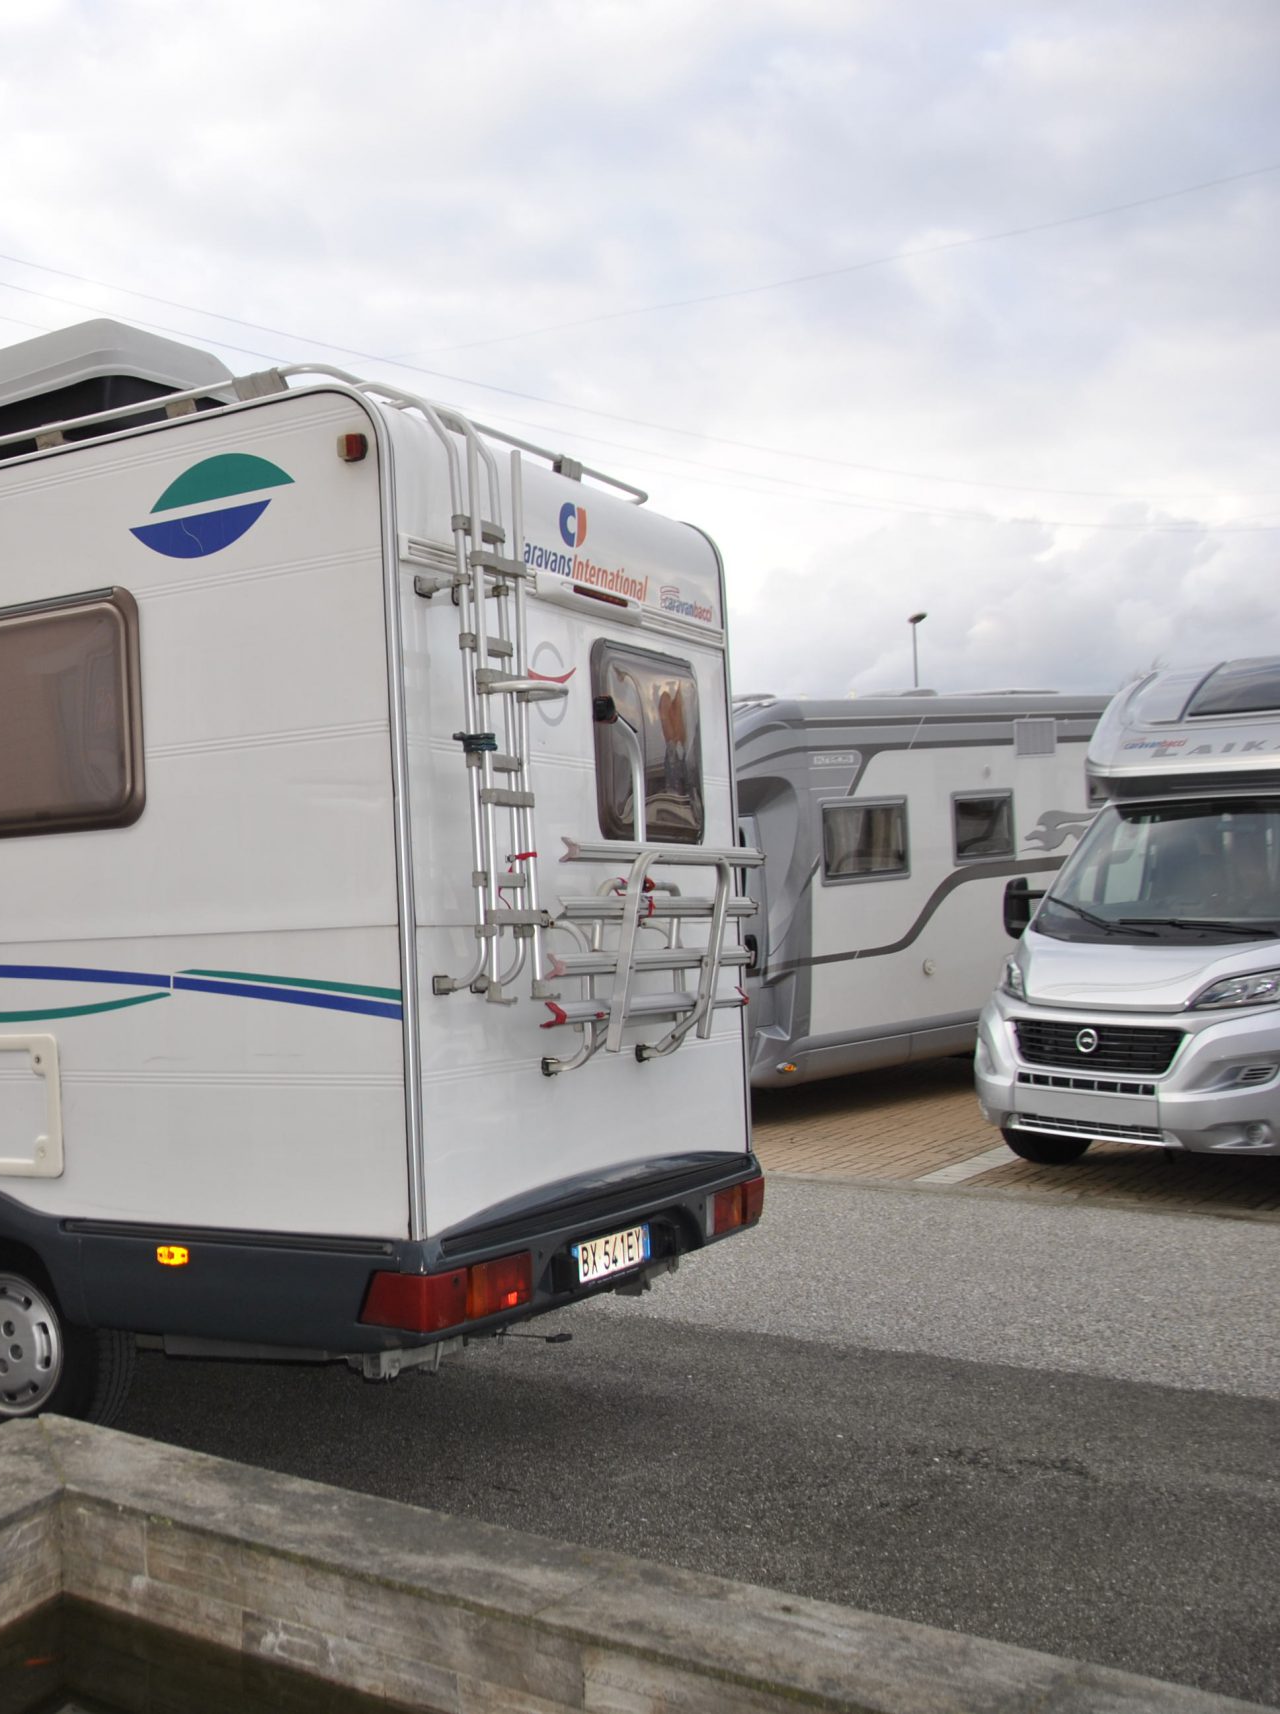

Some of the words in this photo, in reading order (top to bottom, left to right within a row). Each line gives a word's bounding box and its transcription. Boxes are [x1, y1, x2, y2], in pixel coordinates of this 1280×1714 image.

[1151, 740, 1280, 758] LAIK
[582, 1242, 598, 1277] BX
[604, 1229, 641, 1270] 541EY
